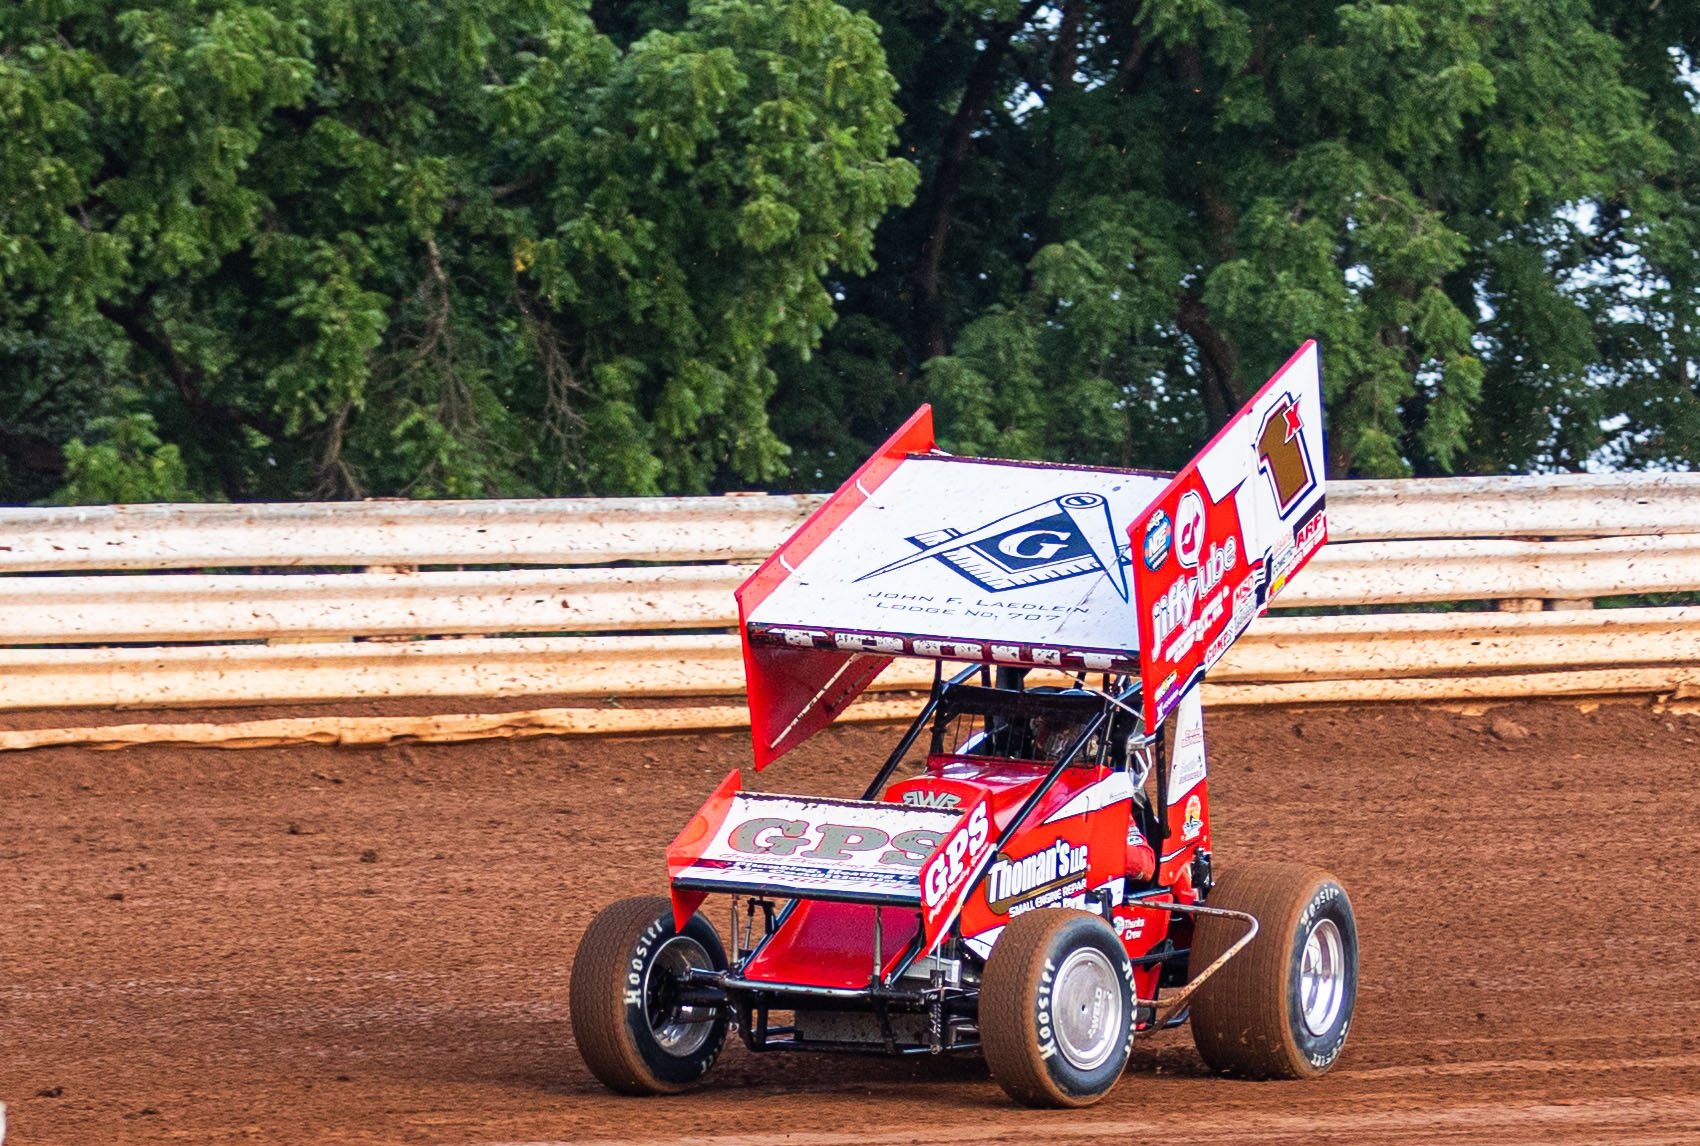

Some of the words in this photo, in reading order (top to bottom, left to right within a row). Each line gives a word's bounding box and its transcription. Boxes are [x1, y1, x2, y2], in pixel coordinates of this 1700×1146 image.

[998, 530, 1071, 559] G
[1297, 513, 1322, 549] ARP
[868, 591, 934, 602] JOHN
[876, 602, 955, 616] LODGE
[1008, 612, 1061, 622] 707
[1152, 574, 1198, 662] jiffy
[767, 628, 1129, 670] TROUT
[728, 818, 950, 867] GPS
[925, 801, 988, 908] GPS
[988, 839, 1070, 904] Thoman's
[624, 918, 664, 1009] Hoosier
[1037, 958, 1058, 1060] Hoosier
